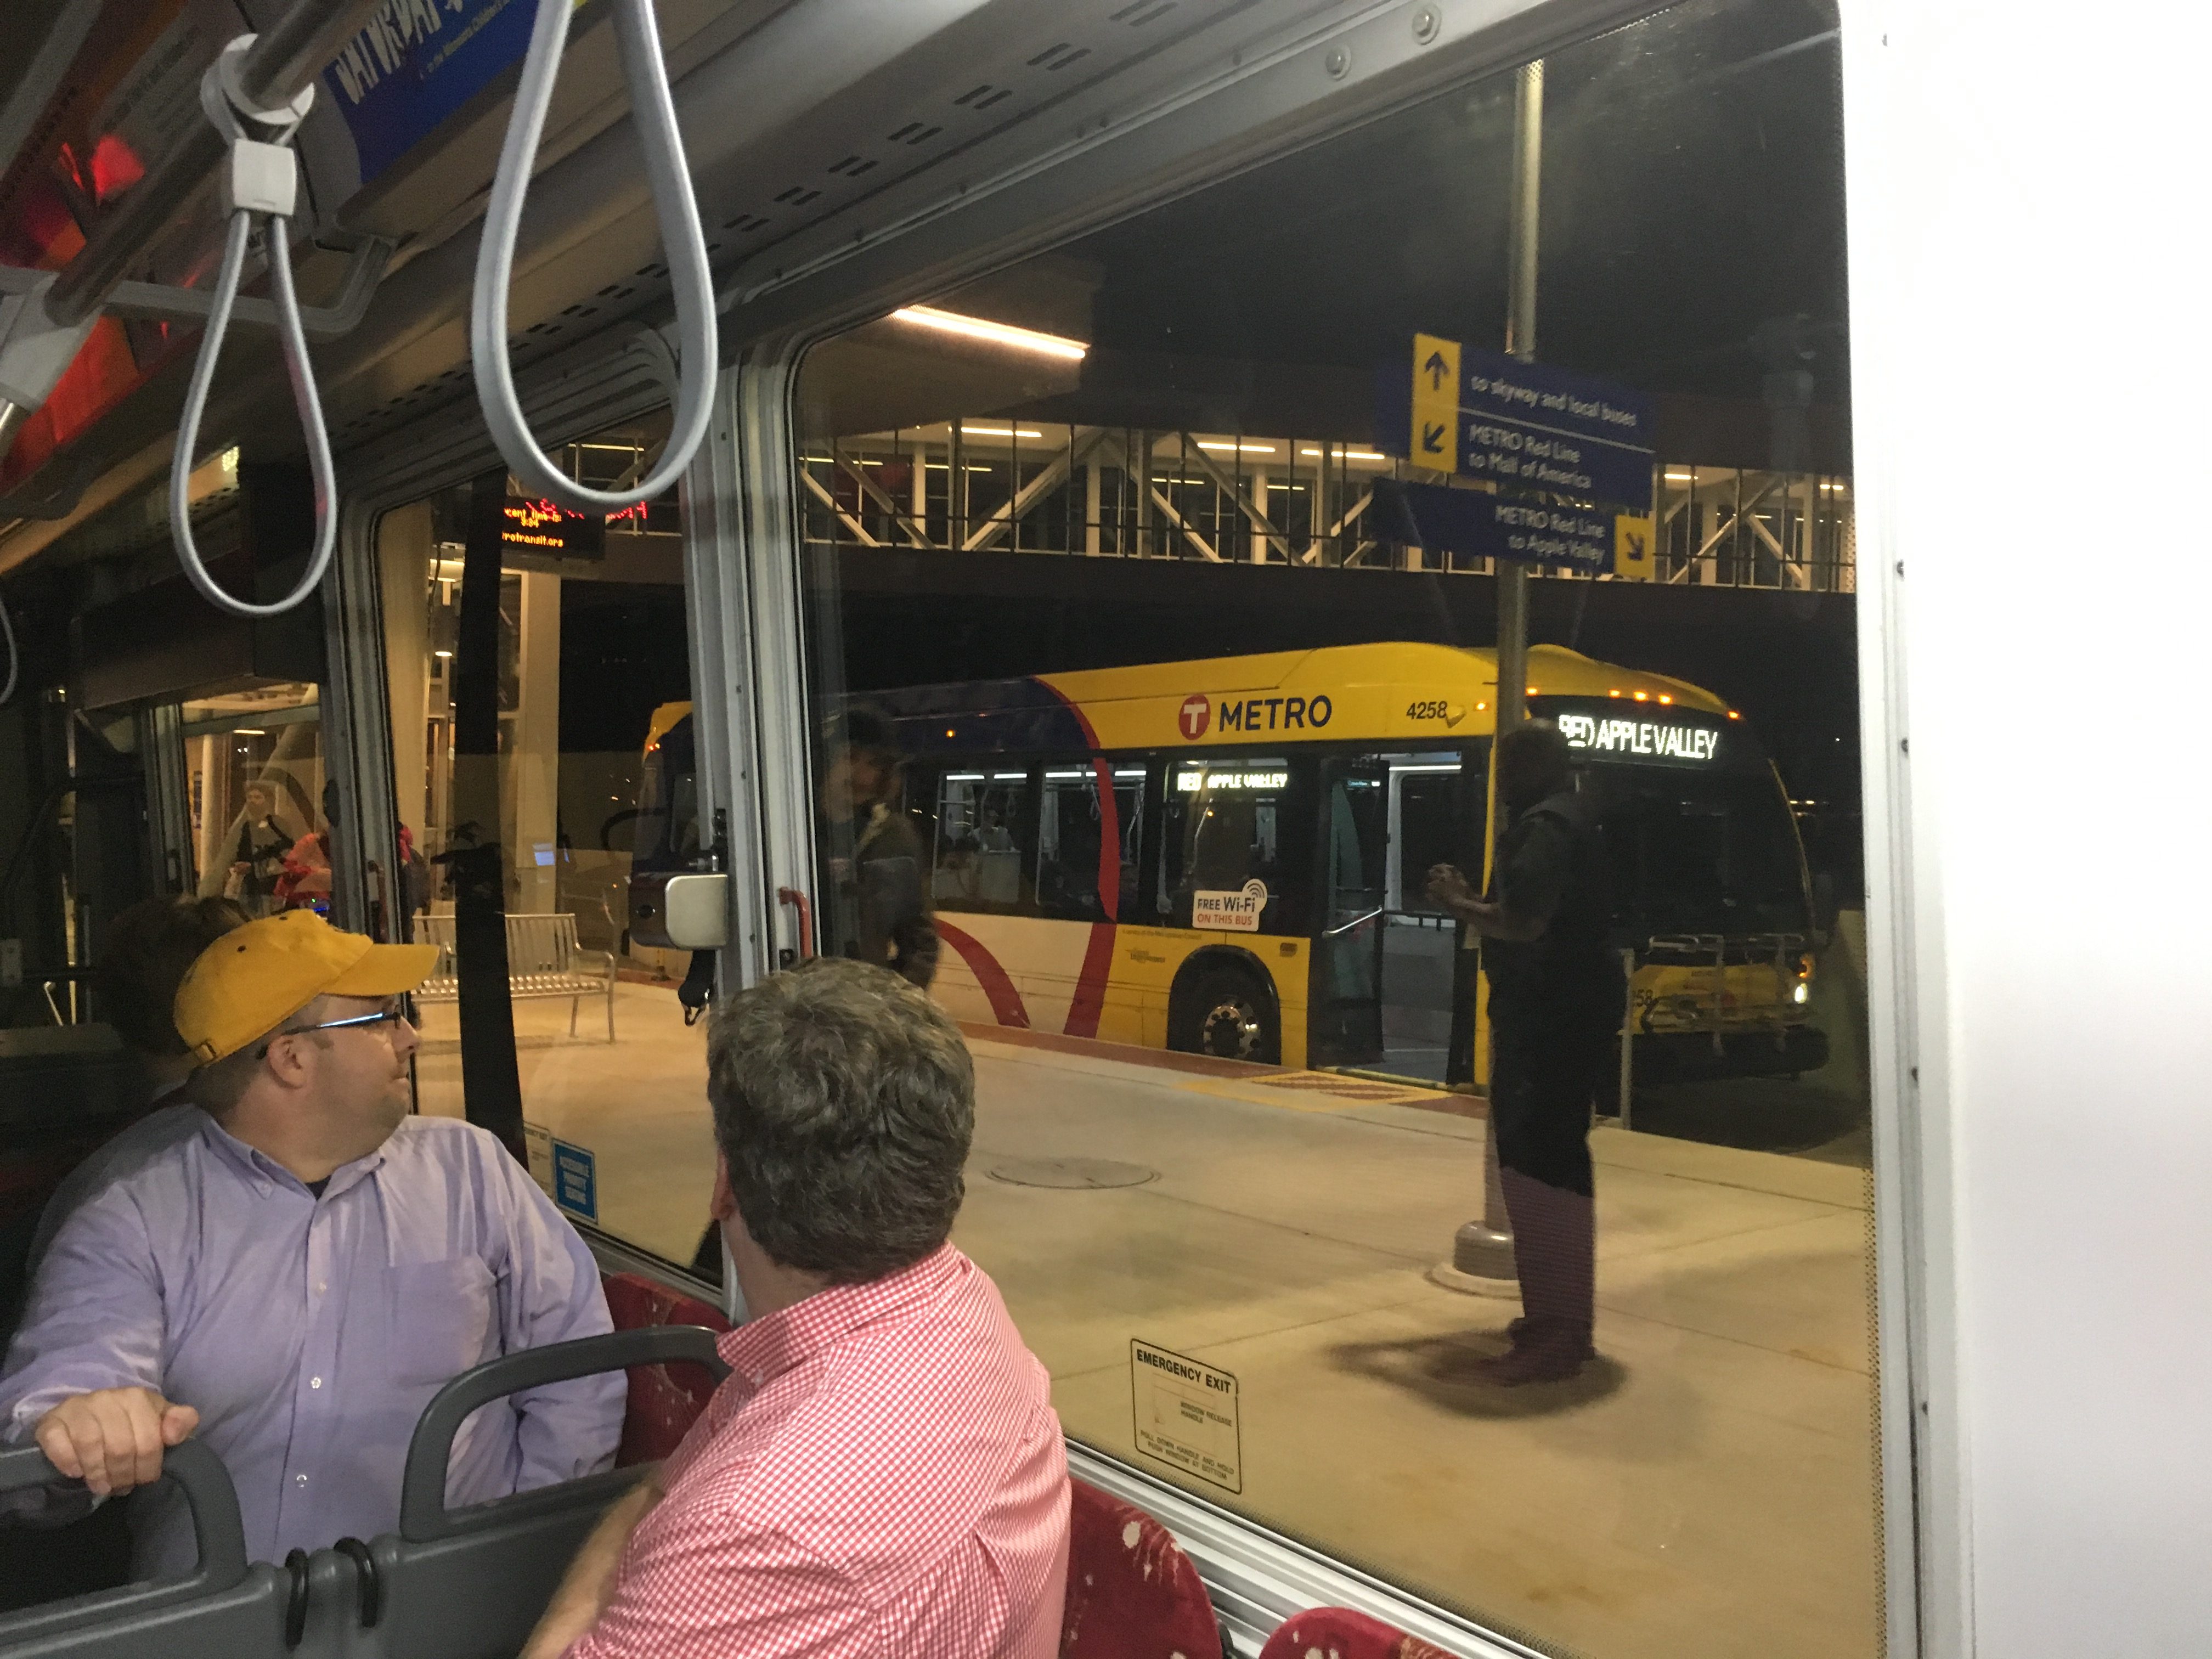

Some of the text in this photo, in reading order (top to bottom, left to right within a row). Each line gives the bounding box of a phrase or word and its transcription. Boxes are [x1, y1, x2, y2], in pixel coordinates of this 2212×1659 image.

[1470, 376, 1637, 427] to skyway and local buses
[1469, 424, 1581, 464] METRO Red Line
[1469, 453, 1592, 489] to Mall of America
[1496, 505, 1606, 539] METRO Red Line
[1508, 534, 1526, 550] to
[1527, 533, 1568, 558] Apple
[1184, 695, 1333, 734] T METRO
[1406, 700, 1448, 720] 4258
[1595, 719, 1652, 754] APPLE
[1653, 725, 1718, 760] VALLEY
[1178, 772, 1288, 791] RED APPLE VALLEY
[1197, 913, 1252, 926] ON THIS BUS
[1198, 896, 1256, 912] FREE Wi-Fi
[1136, 1348, 1231, 1394] EMERGENCY EXIT
[1206, 1411, 1232, 1427] RELEASE
